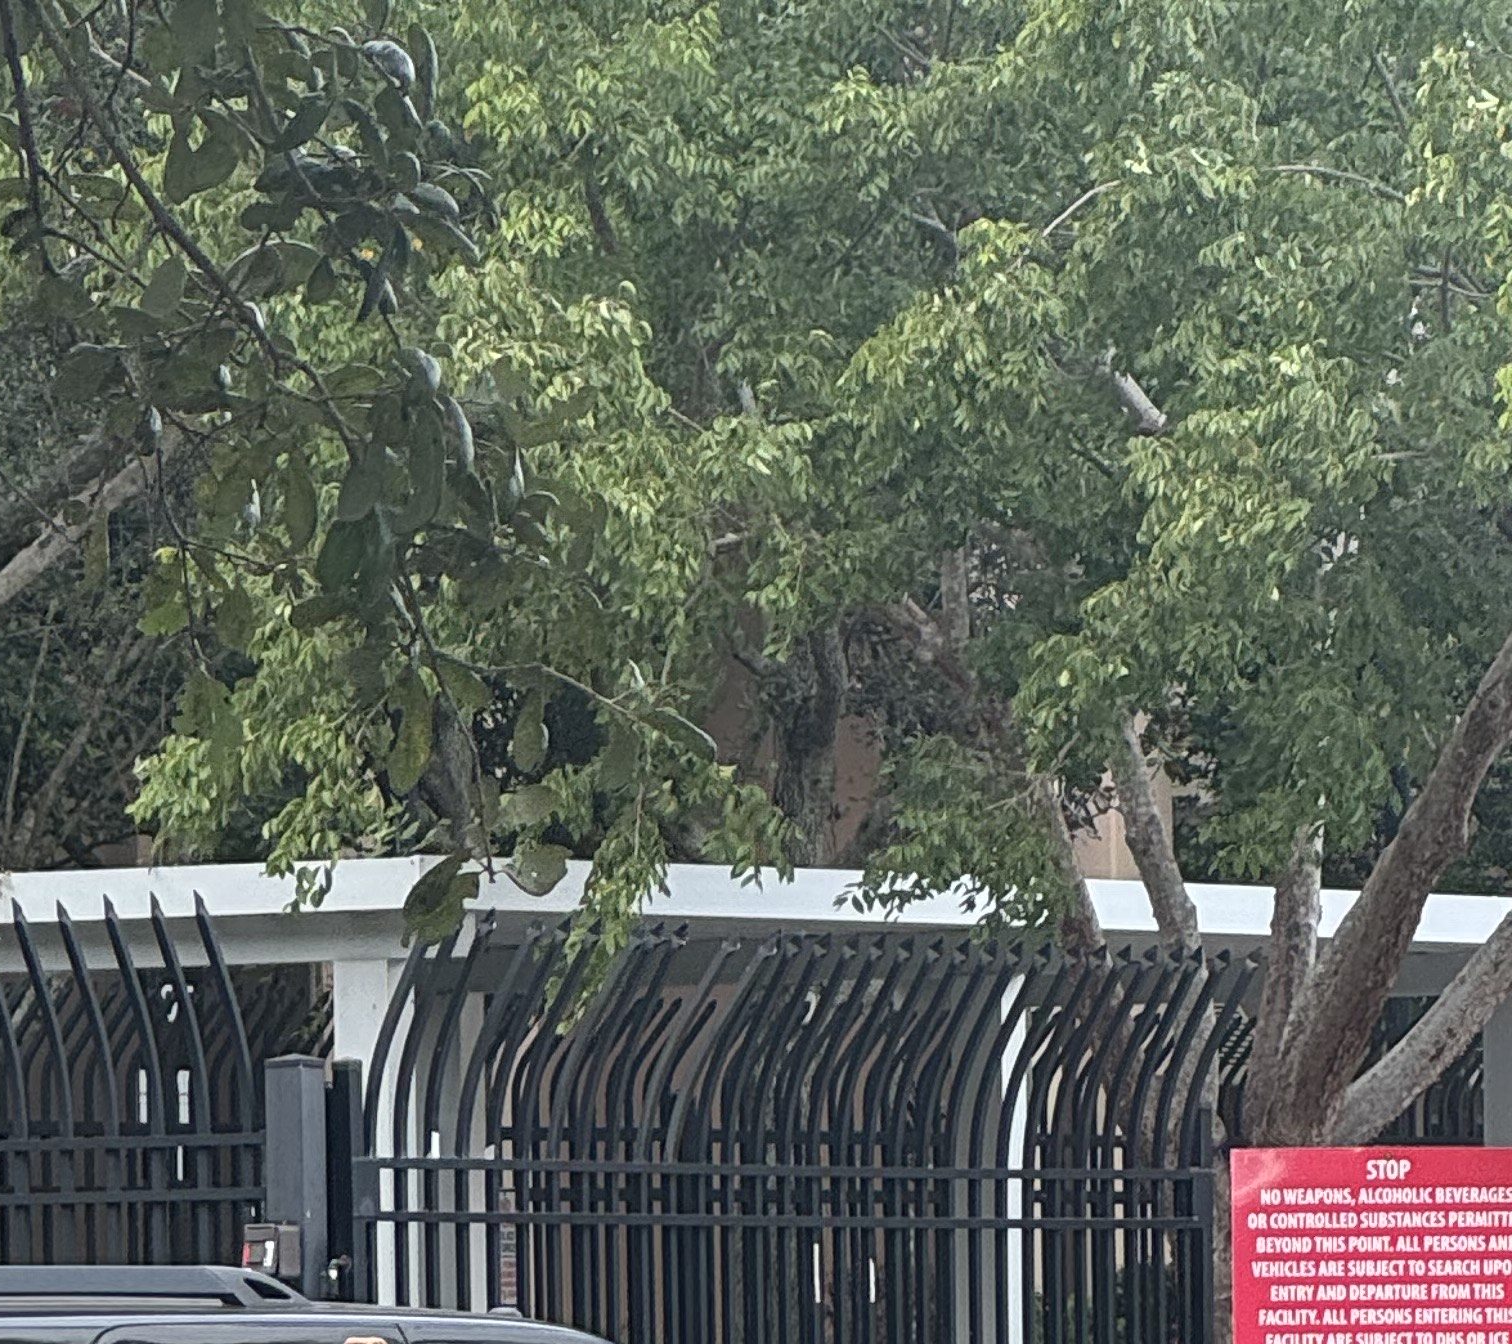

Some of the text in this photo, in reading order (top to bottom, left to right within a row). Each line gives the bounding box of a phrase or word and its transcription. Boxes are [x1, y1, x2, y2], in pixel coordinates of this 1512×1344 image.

[1366, 1158, 1411, 1181] STOP
[1261, 1186, 1512, 1207] NO WEAPONS, ALCOHOLIC BEVERAGES
[1248, 1212, 1267, 1230] OR
[1270, 1211, 1357, 1230] CONTROLLED
[1360, 1210, 1445, 1229] SUBSTANCES
[1256, 1236, 1311, 1254] BEYOND
[1315, 1235, 1346, 1253] THIS
[1349, 1235, 1394, 1253] POINT.
[1396, 1235, 1421, 1253] ALL
[1424, 1235, 1486, 1253] PERSONS
[1251, 1260, 1315, 1278] VEHICLES
[1318, 1259, 1345, 1277] ARE
[1348, 1259, 1406, 1278] SUBJECT
[1408, 1259, 1425, 1277] TO
[1428, 1259, 1480, 1277] SEARCH
[1270, 1282, 1504, 1302] ENTRY AND DEPARTURE FROM THIS
[1258, 1308, 1320, 1326] FACILITY.
[1323, 1308, 1347, 1326] ALL
[1350, 1307, 1412, 1326] PERSONS
[1415, 1307, 1482, 1325] ENTERING
